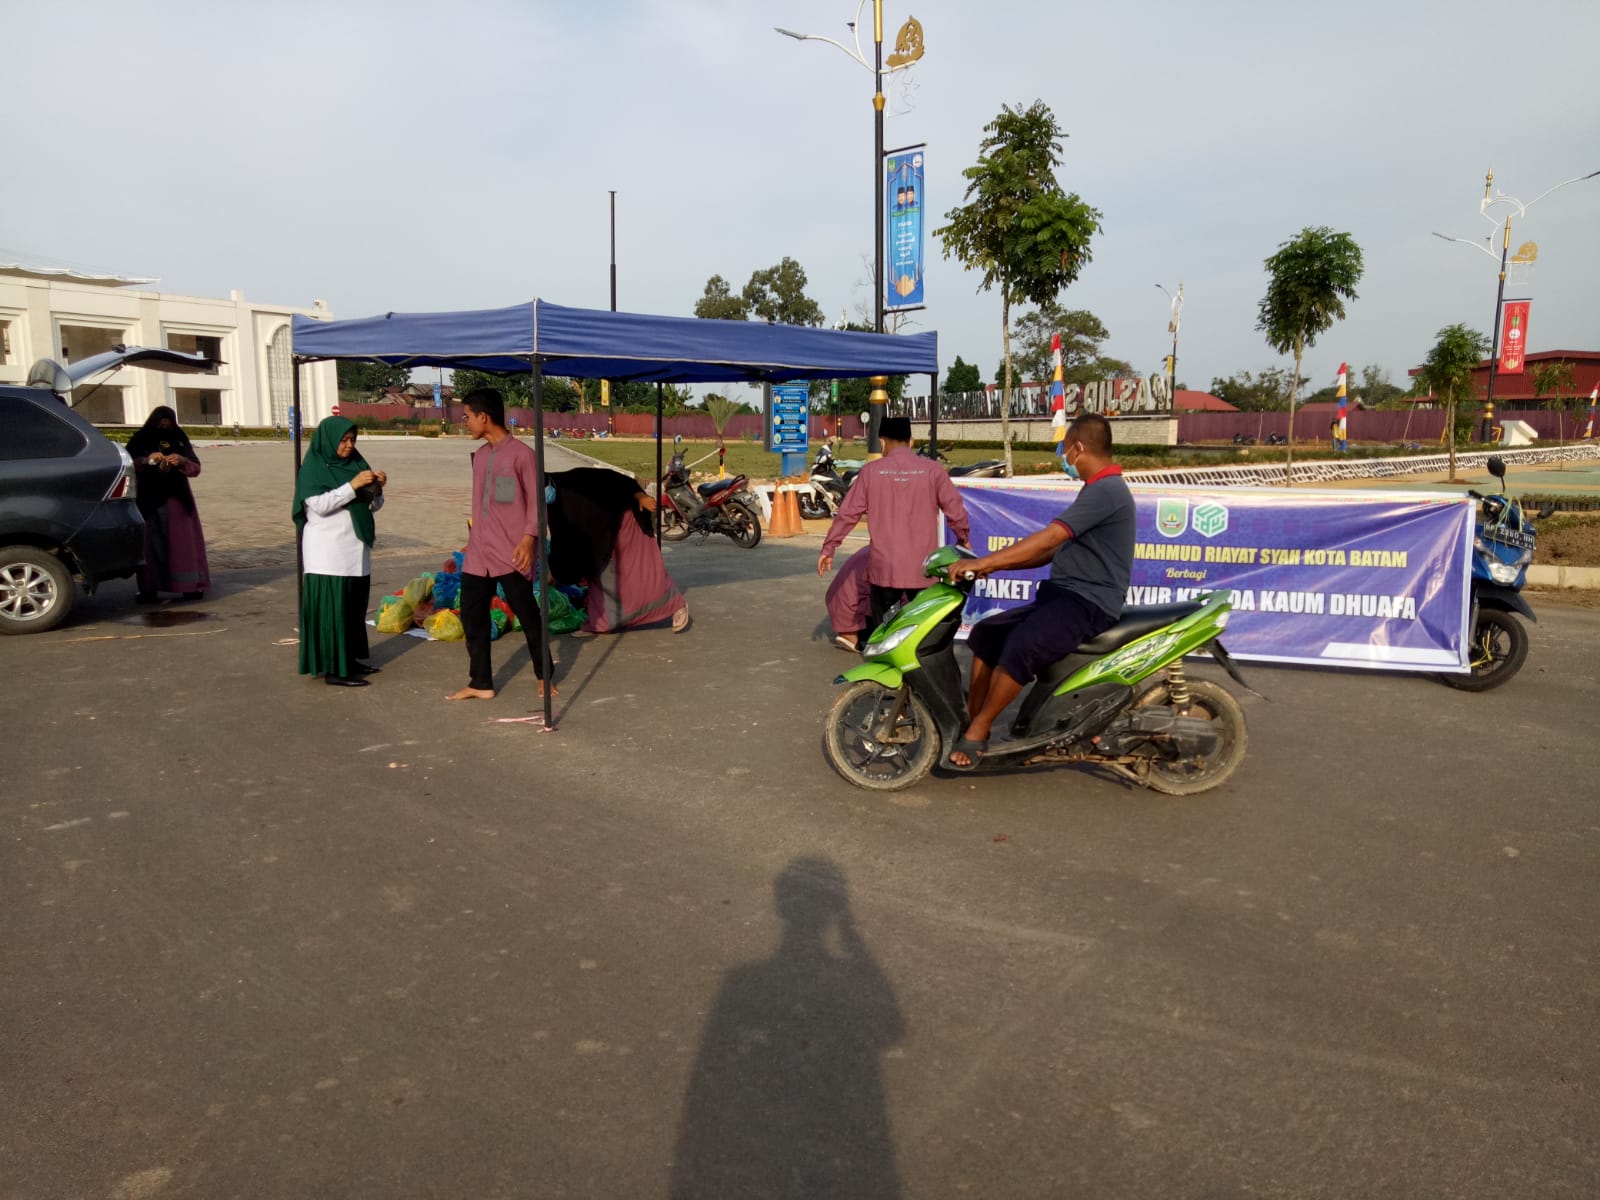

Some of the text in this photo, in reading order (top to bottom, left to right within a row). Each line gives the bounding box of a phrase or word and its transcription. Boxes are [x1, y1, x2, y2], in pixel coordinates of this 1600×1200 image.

[1133, 543, 1202, 562] MAHMUD
[1204, 546, 1258, 564] RIAYAT
[1303, 550, 1346, 566] KOTA
[1349, 551, 1408, 568] BATAM
[1165, 567, 1208, 581] Berbagi
[974, 578, 1033, 601] PAKET
[1259, 590, 1325, 615] KAUM
[1330, 593, 1416, 620] DHUAFA
